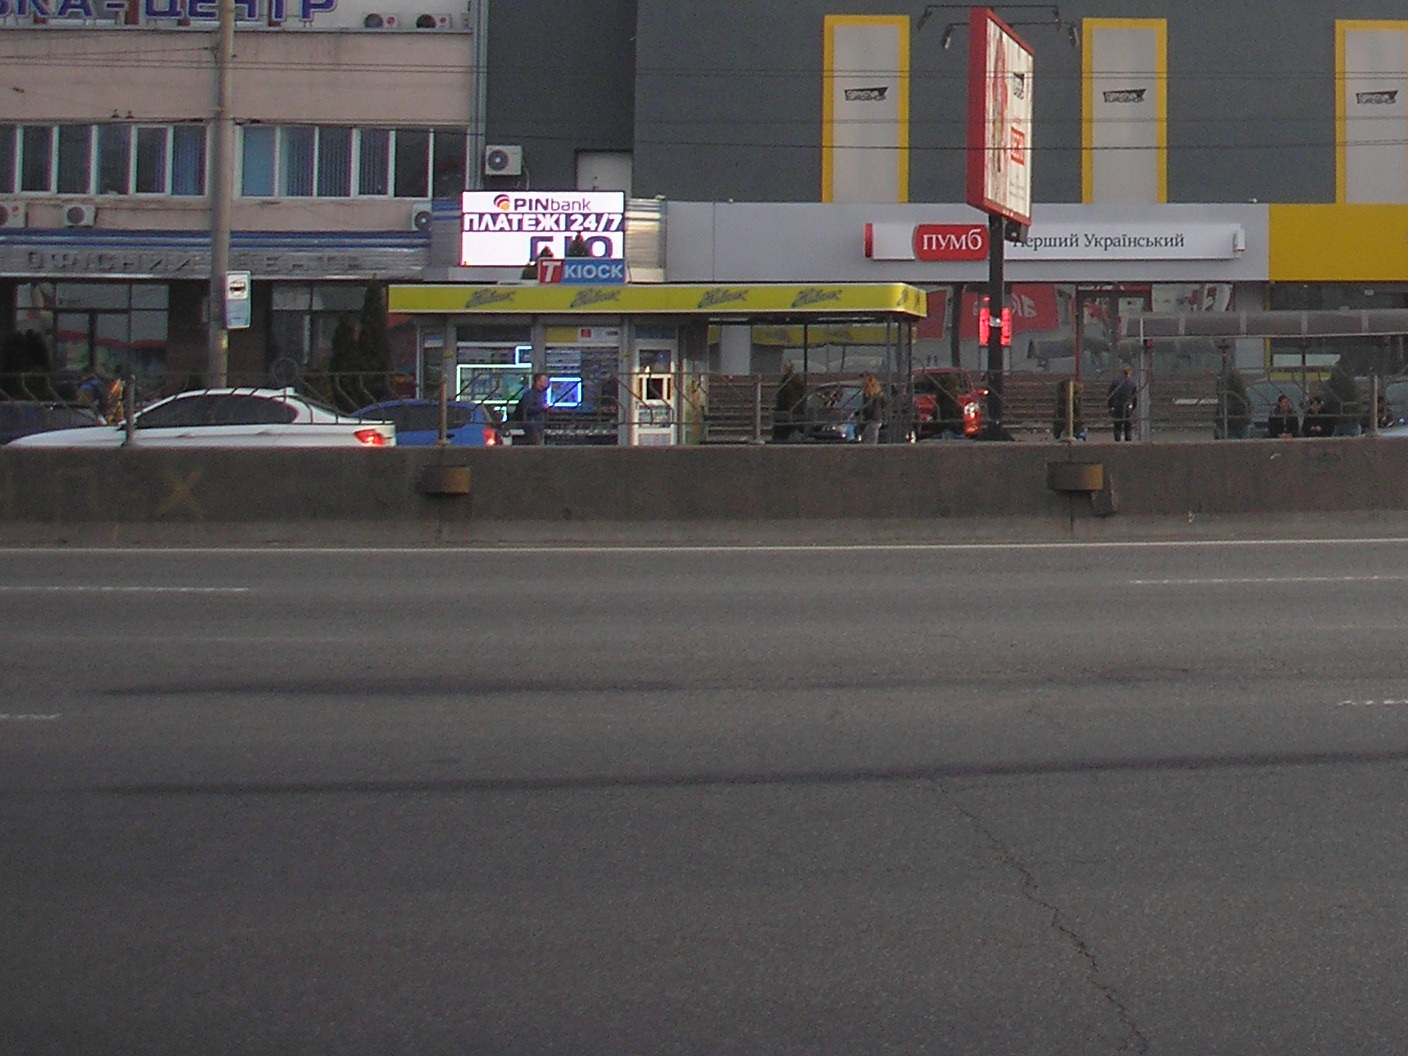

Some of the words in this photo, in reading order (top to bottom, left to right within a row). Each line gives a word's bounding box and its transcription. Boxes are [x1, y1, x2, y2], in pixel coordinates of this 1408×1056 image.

[514, 197, 592, 212] PINbank
[464, 213, 566, 232] ПЛАТЕЖІ
[570, 213, 623, 232] 24/7
[1084, 233, 1185, 252] Український
